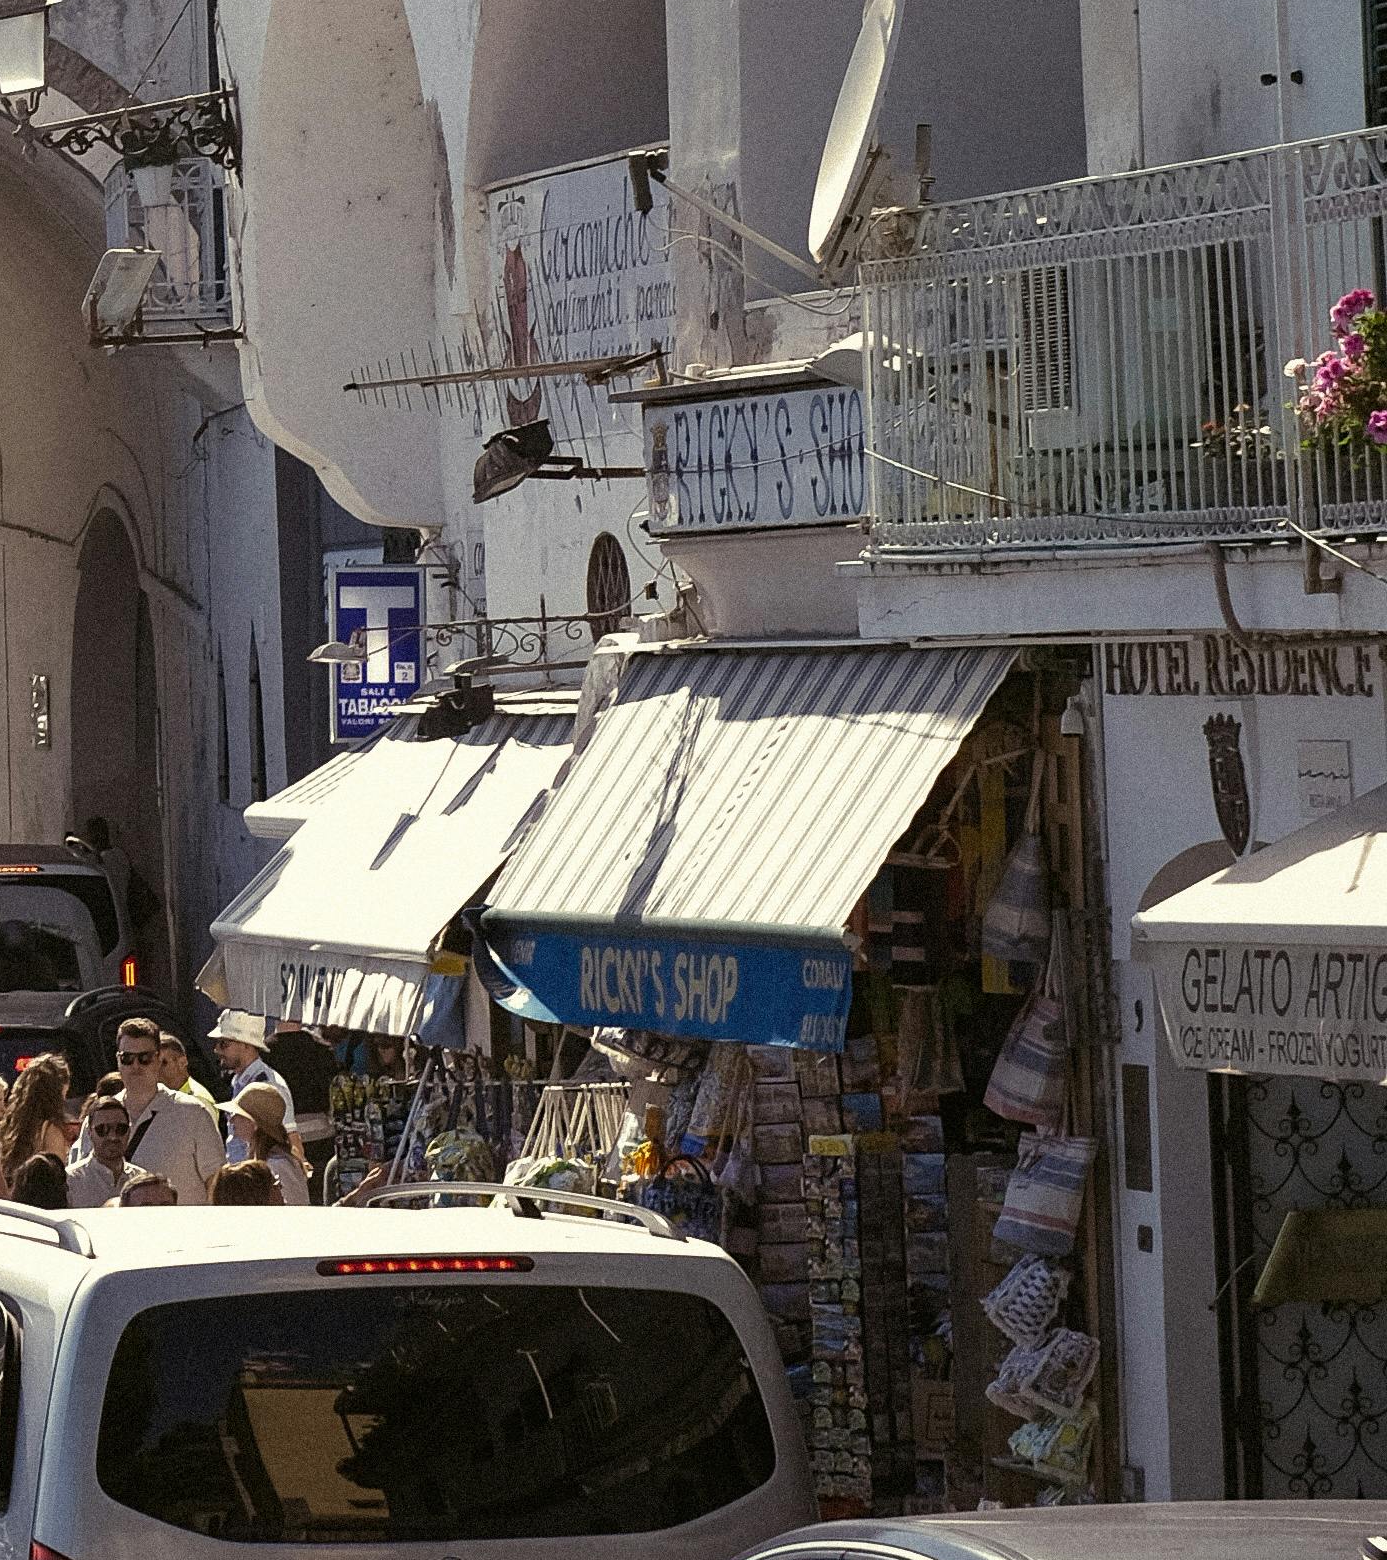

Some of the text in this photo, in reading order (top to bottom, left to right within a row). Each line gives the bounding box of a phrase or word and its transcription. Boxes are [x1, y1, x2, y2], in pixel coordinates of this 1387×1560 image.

[673, 389, 865, 526] RICKY'S SHO
[1105, 633, 1373, 697] HOTEL RESIDENCE
[580, 946, 739, 1025] RICKY'S SHOP
[1181, 947, 1292, 1017] GELATO
[1207, 1027, 1255, 1064] CREAM
[1267, 1030, 1324, 1066] FROZEN
